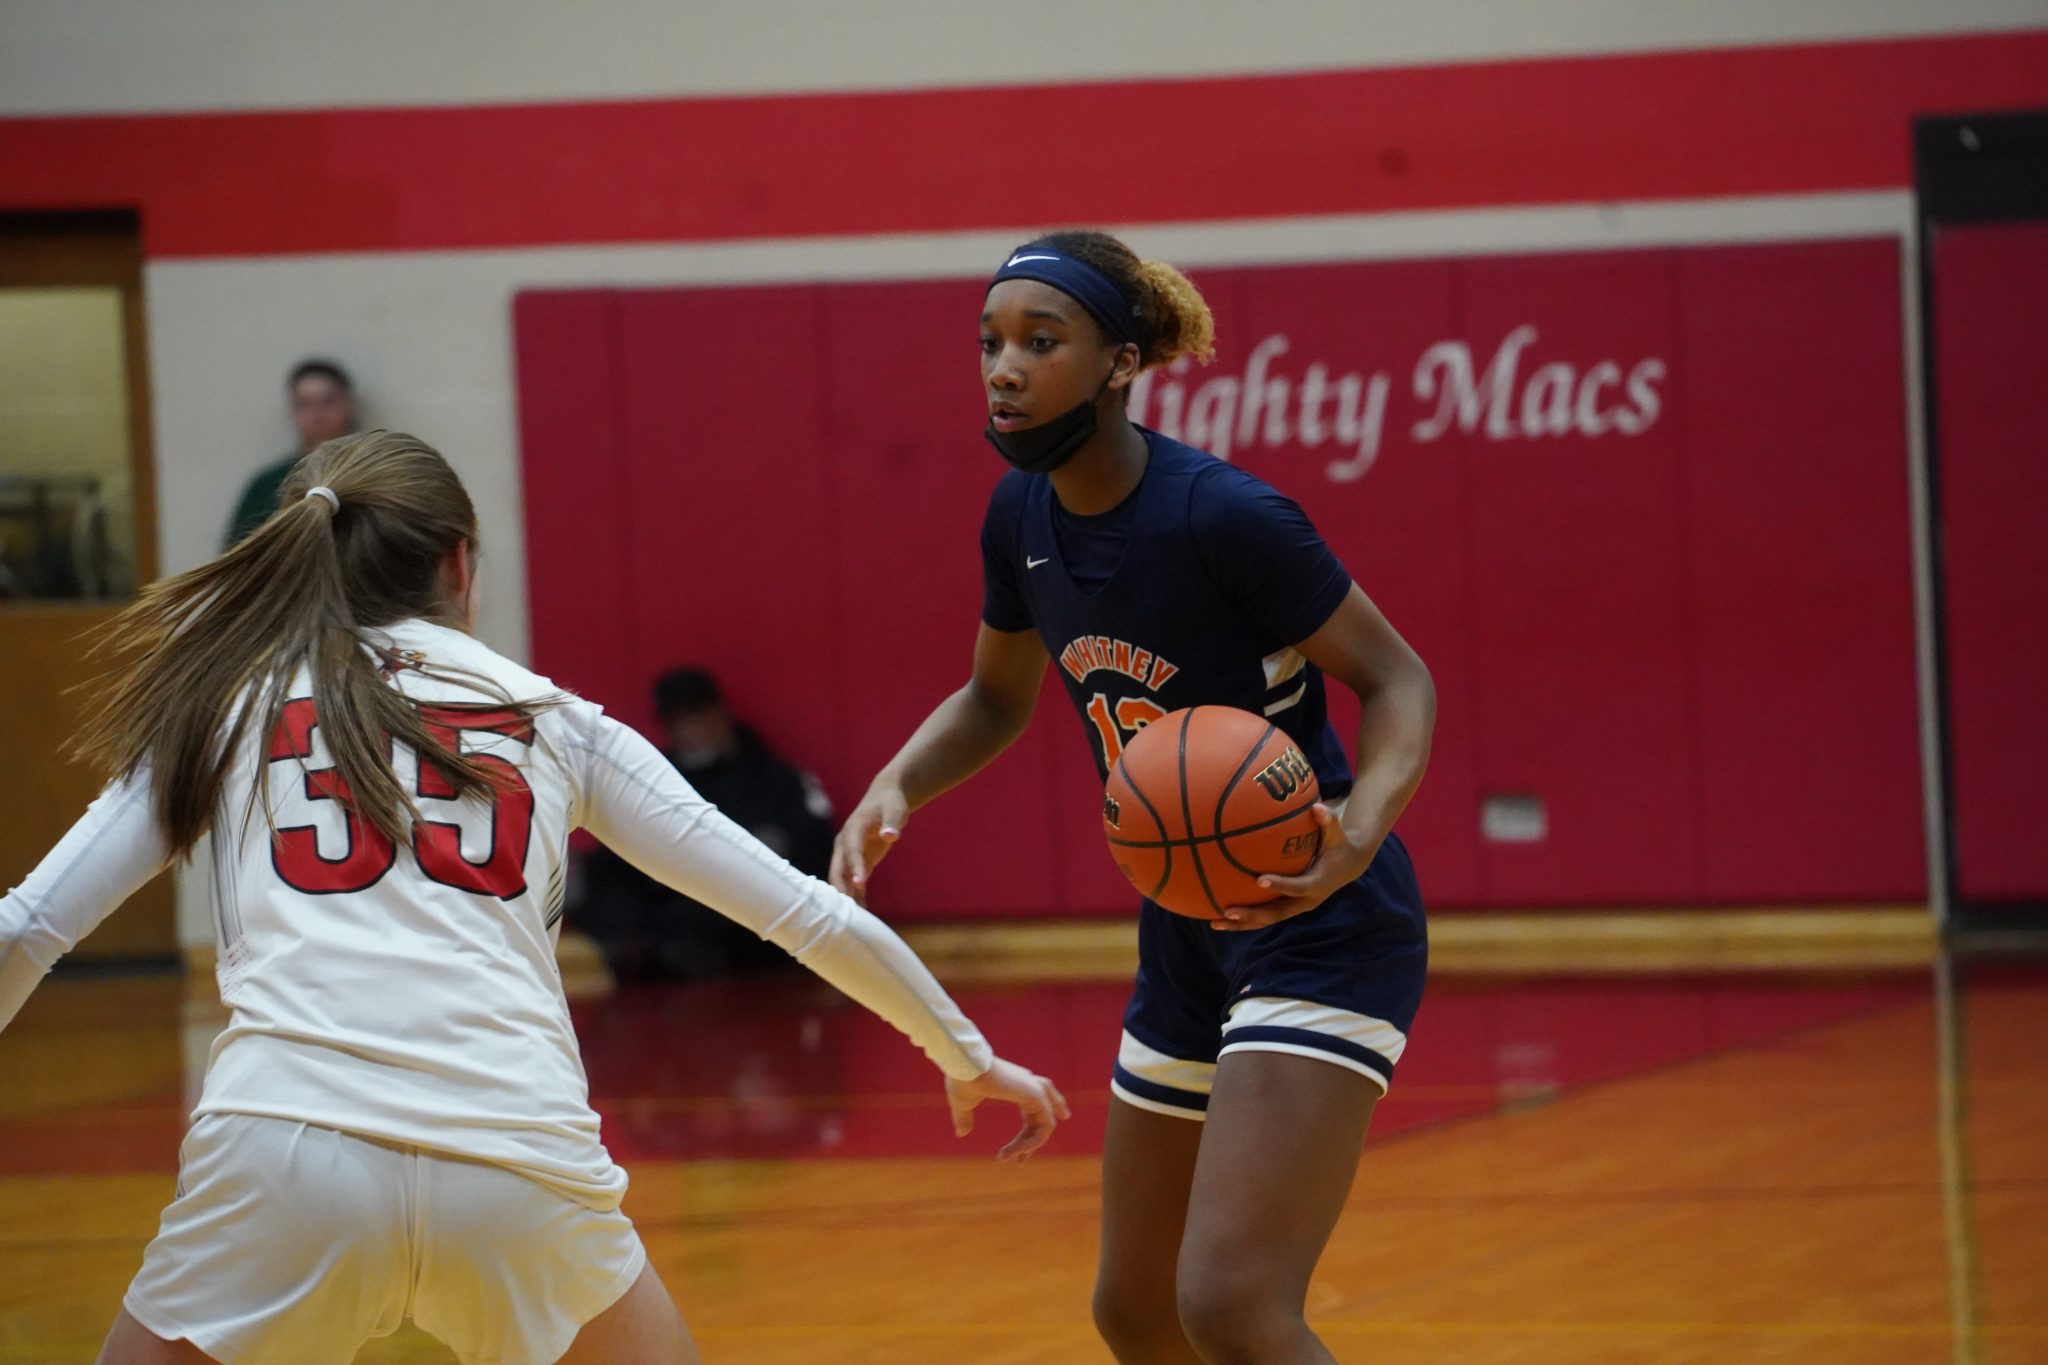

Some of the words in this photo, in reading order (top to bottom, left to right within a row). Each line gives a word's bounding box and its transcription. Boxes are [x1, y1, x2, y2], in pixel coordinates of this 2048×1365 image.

[1126, 333, 1389, 483] ighty
[1411, 325, 1666, 442] Macs
[1060, 635, 1179, 692] WHITNEY
[269, 697, 536, 901] 35
